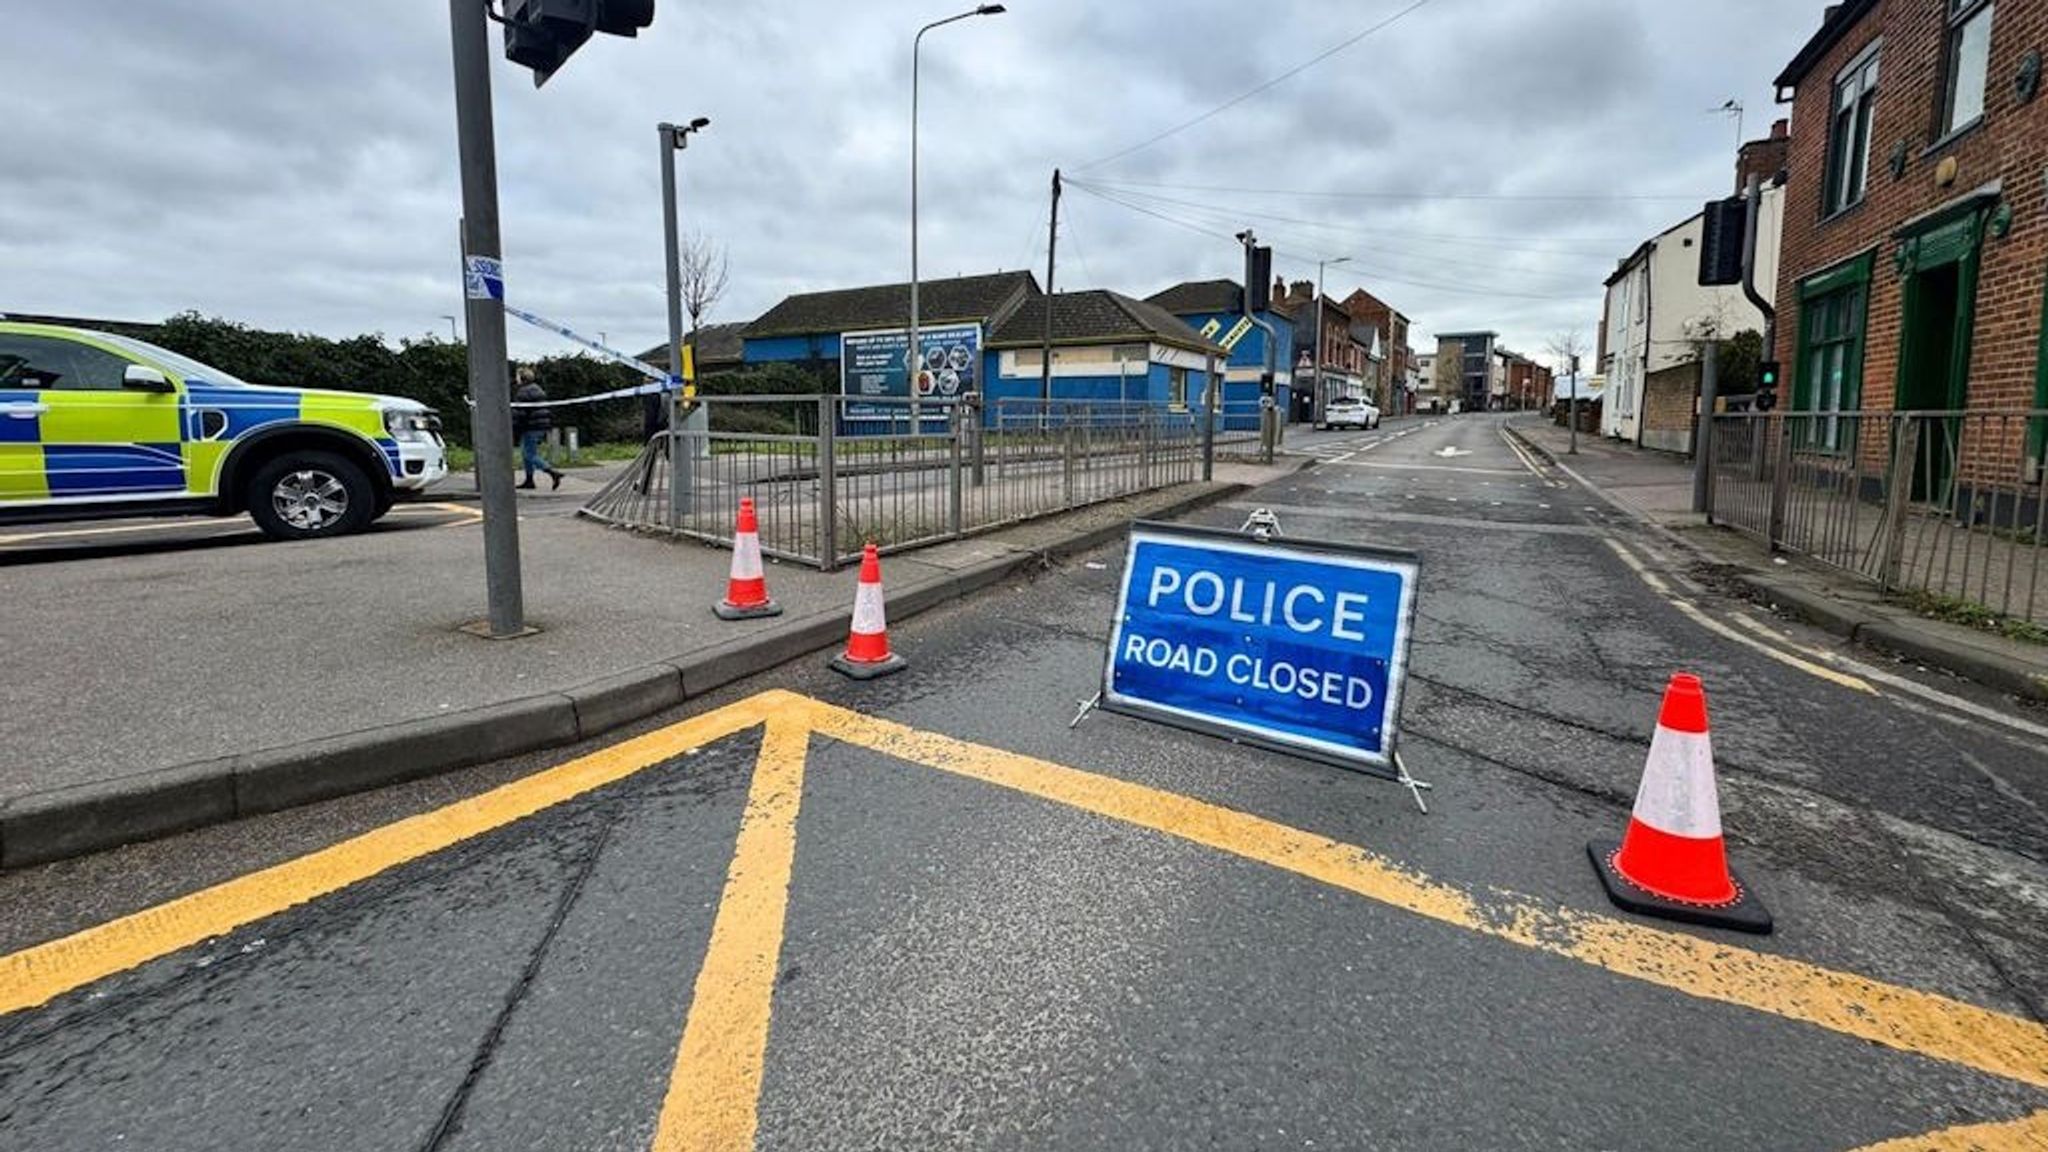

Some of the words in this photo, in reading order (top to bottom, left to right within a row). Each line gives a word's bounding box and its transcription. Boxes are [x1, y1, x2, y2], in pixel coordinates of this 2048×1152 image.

[1148, 566, 1369, 642] POLICE
[1124, 634, 1218, 677] ROAD
[1226, 654, 1373, 710] CLOSED
